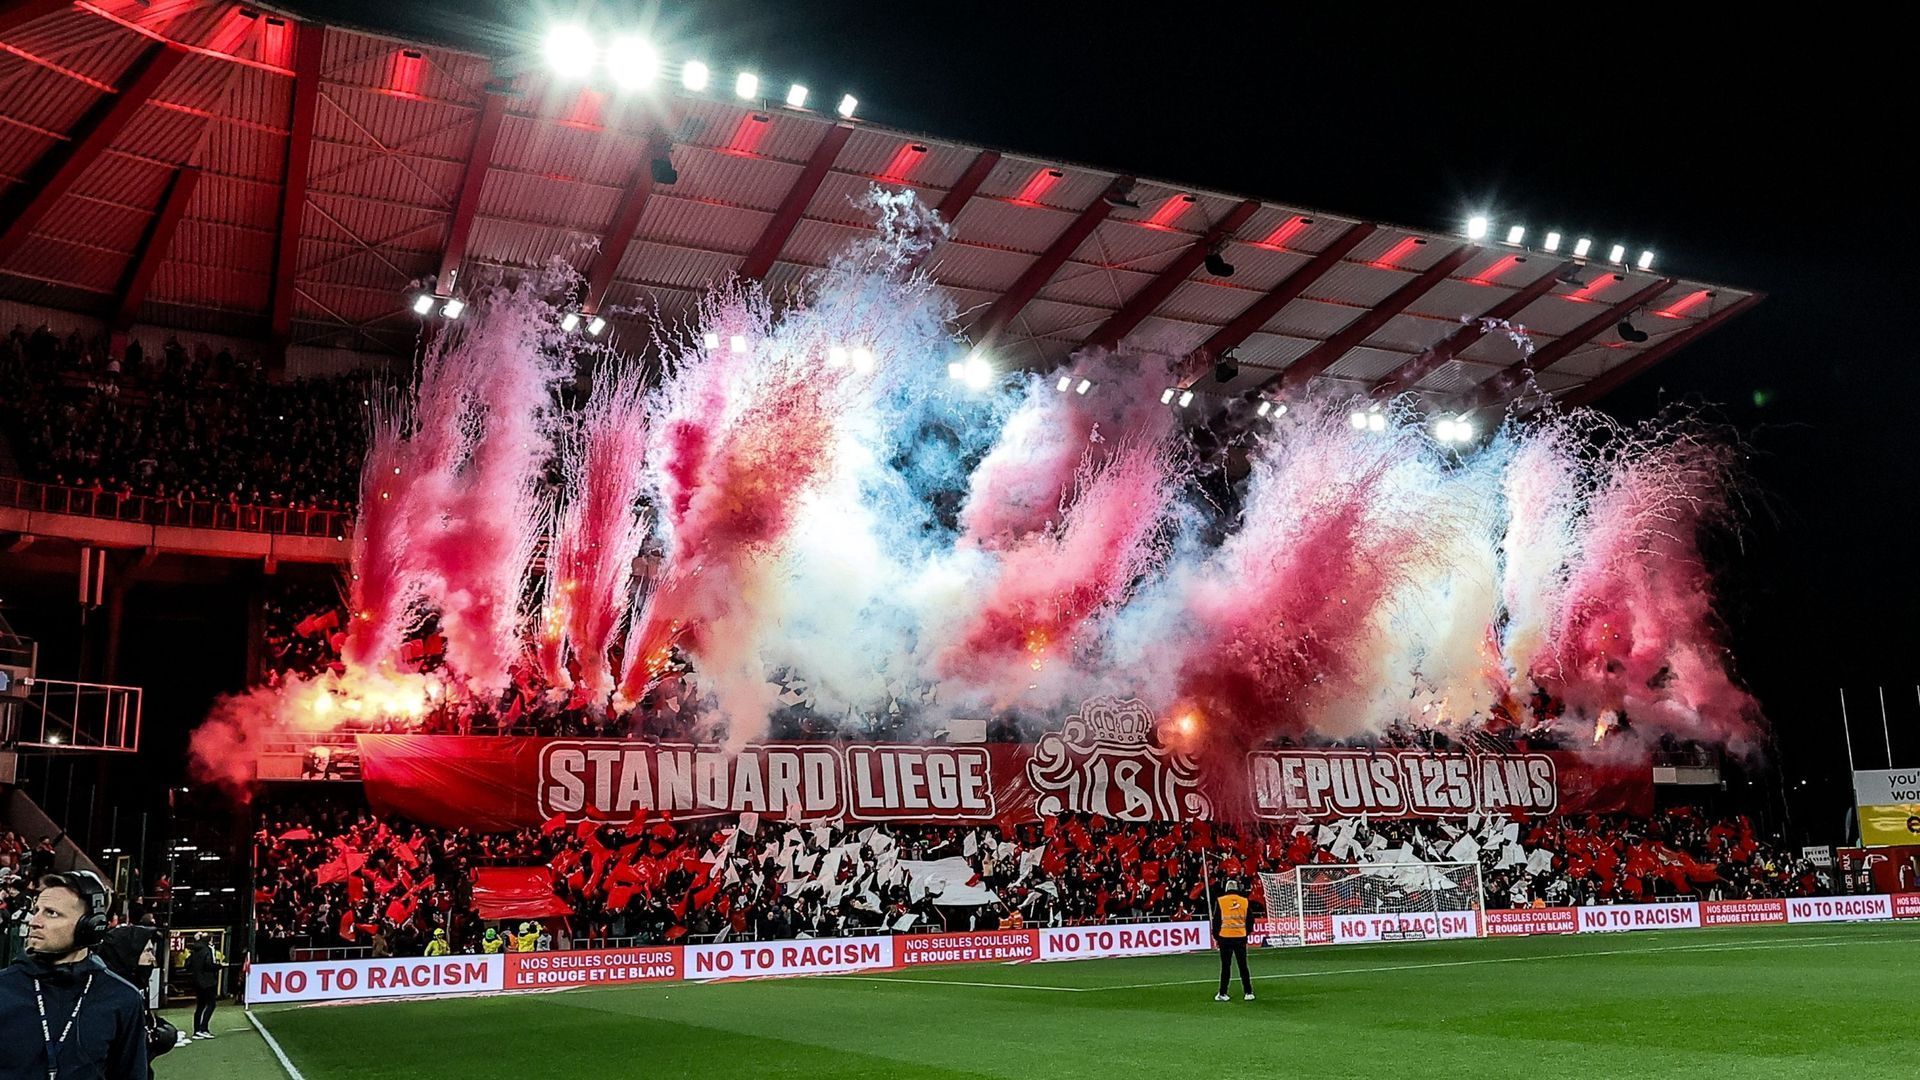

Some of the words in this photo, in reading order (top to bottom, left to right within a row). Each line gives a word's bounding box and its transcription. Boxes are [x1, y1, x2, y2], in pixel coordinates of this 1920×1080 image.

[549, 749, 836, 812] STANDARD
[855, 752, 986, 809] LIEGE
[1254, 757, 1400, 808] DEPUIS
[1405, 758, 1471, 807] 125
[1483, 758, 1554, 807] ANS
[1722, 904, 1746, 913] SEULES
[1747, 903, 1780, 911] COULEURS
[1793, 903, 1811, 917] NO
[1815, 902, 1831, 916] TO
[1835, 900, 1885, 915] RACISM
[1897, 906, 1904, 914] LE
[1503, 913, 1530, 922] SEULES
[1532, 912, 1571, 920] COULEURS
[1585, 911, 1606, 927] NO
[1611, 910, 1630, 926] TO
[1635, 908, 1692, 924] RACISM
[1716, 914, 1740, 923] ROUGE
[1741, 914, 1749, 922] ET
[1761, 912, 1783, 920] BLANC
[1253, 922, 1276, 932] ULES
[1341, 920, 1366, 938] NO
[1371, 919, 1394, 936] TO
[1399, 917, 1467, 935] RACSM
[1495, 924, 1523, 933] ROUGE
[1525, 924, 1534, 932] ET
[1536, 923, 1545, 931] LE
[1547, 922, 1573, 930] BLANC
[906, 939, 928, 950] NOS
[932, 937, 972, 948] SEULES
[974, 934, 1029, 946] COULEURS
[1049, 933, 1079, 952] NO
[1085, 932, 1113, 950] TO
[1120, 928, 1200, 949] RACISM
[521, 958, 548, 969] NOS
[552, 954, 600, 968] SEULES
[604, 952, 672, 965] COULEURS
[696, 951, 733, 972] NO
[741, 949, 774, 969] TO
[783, 943, 880, 967] RACISM
[904, 953, 917, 962] LE
[921, 951, 960, 962] ROUGE
[963, 950, 976, 959] ET
[980, 949, 992, 958] LE
[995, 947, 1032, 958] BLANC
[260, 971, 307, 994] NO
[317, 968, 357, 991] TO
[368, 962, 488, 989] RACISM
[517, 972, 534, 984] LE
[538, 970, 585, 983] ROUGE
[590, 969, 606, 981] ET
[610, 968, 625, 980] LE
[629, 965, 674, 978] BLANC
